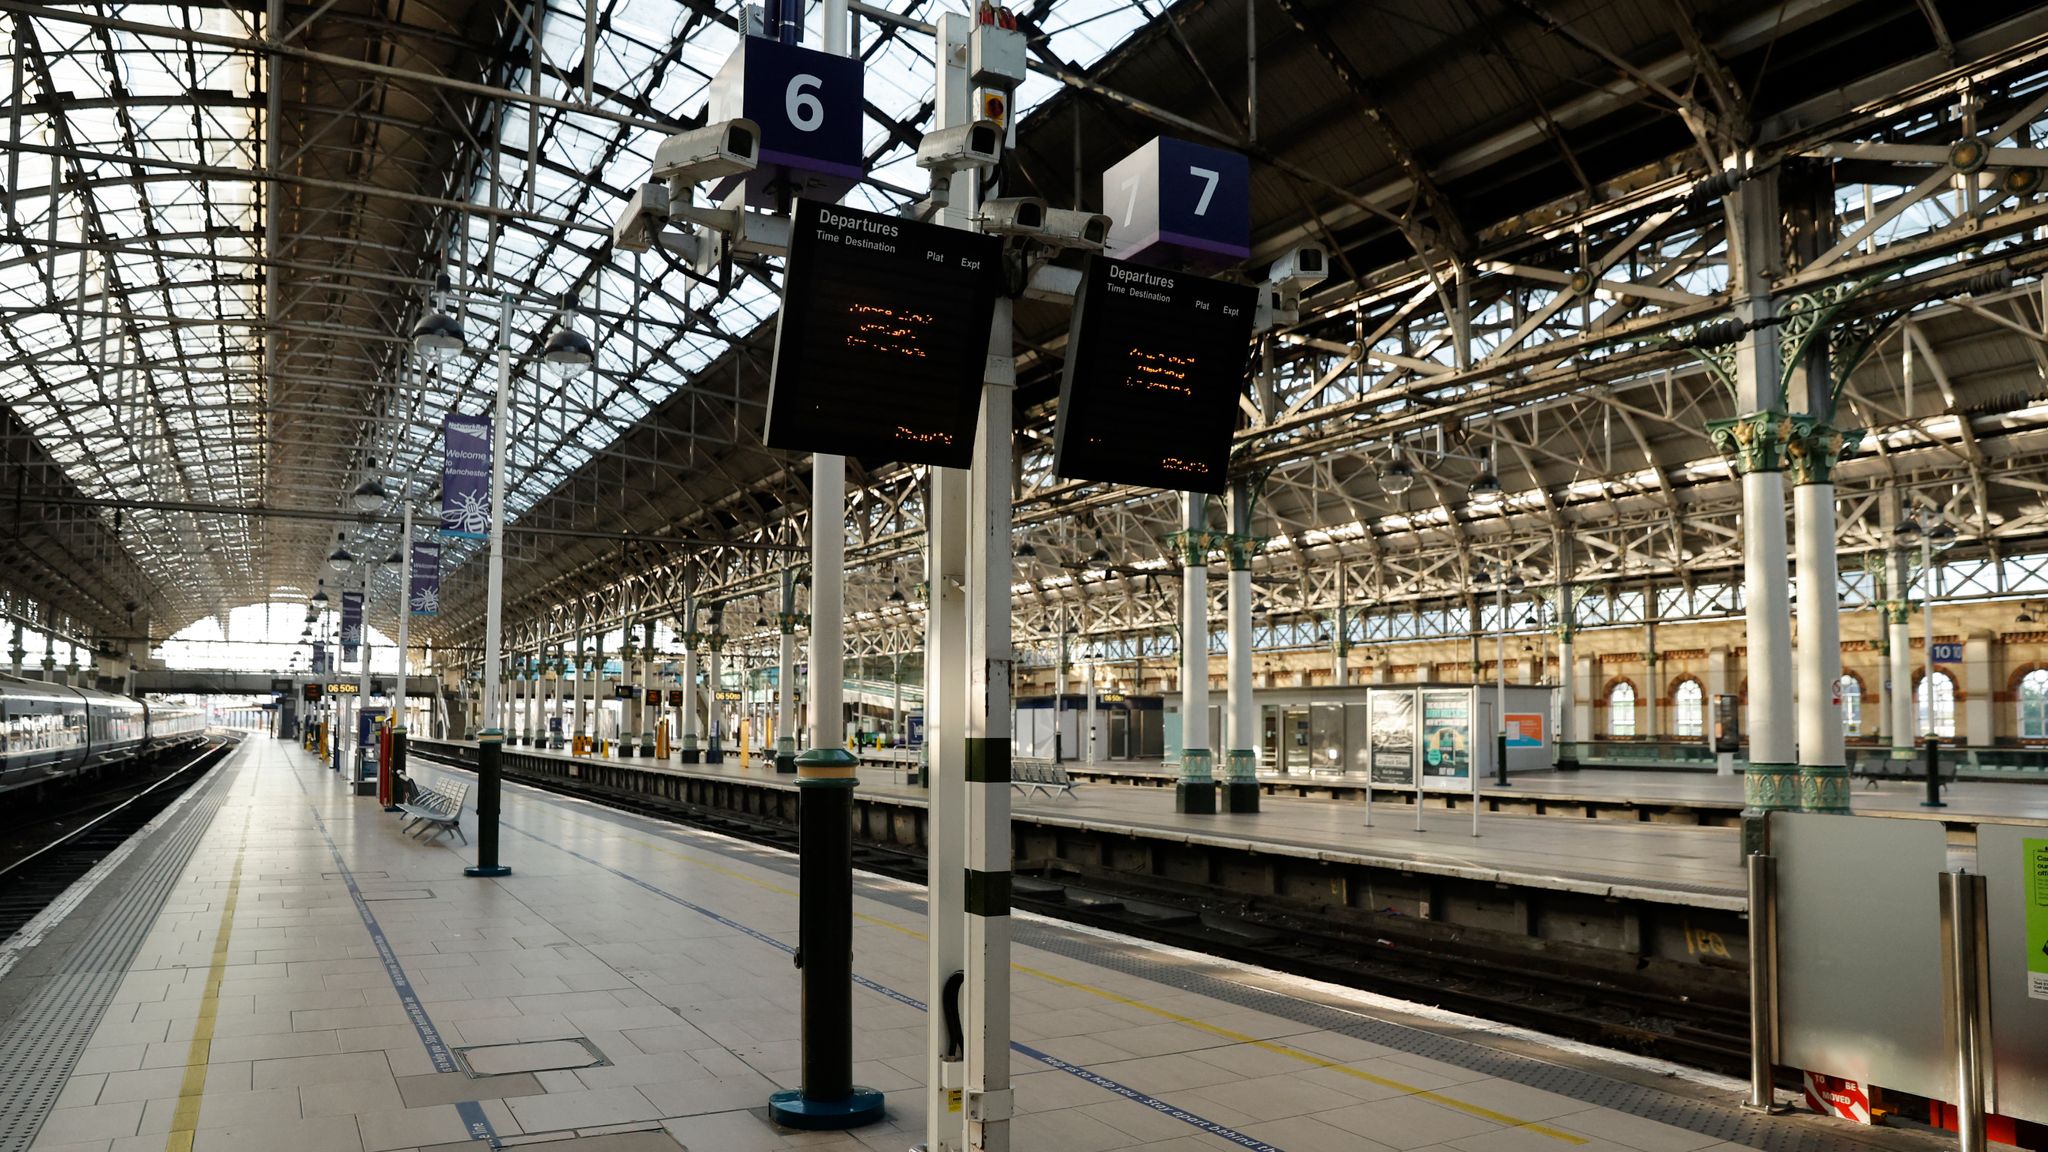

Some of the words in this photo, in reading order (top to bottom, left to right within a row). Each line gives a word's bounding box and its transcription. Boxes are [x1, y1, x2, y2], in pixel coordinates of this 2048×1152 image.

[785, 74, 824, 132] 6
[1121, 174, 1141, 228] 7
[1190, 166, 1220, 216] 7
[819, 209, 899, 237] Departures
[816, 230, 840, 243] Time
[845, 235, 896, 253] Destination
[926, 251, 944, 263] Plat
[961, 258, 981, 270] Expt
[1110, 265, 1175, 289] Departures
[1107, 283, 1125, 294] Time
[1129, 287, 1171, 303] Destination
[1195, 300, 1210, 311] Plat
[1223, 306, 1240, 317] Expt
[446, 450, 487, 460] Welcome
[445, 468, 488, 477] Manchester
[1934, 645, 1951, 659] 10
[1815, 1075, 1825, 1084] TO
[1845, 1081, 1857, 1092] BE
[1041, 1057, 1066, 1067] Help
[1090, 1077, 1115, 1088] help
[1110, 1088, 1138, 1097] you
[1143, 1099, 1173, 1112] Stay
[1172, 1111, 1210, 1127] apart
[1208, 1125, 1260, 1146] behind
[1822, 1091, 1851, 1105] MOVED
